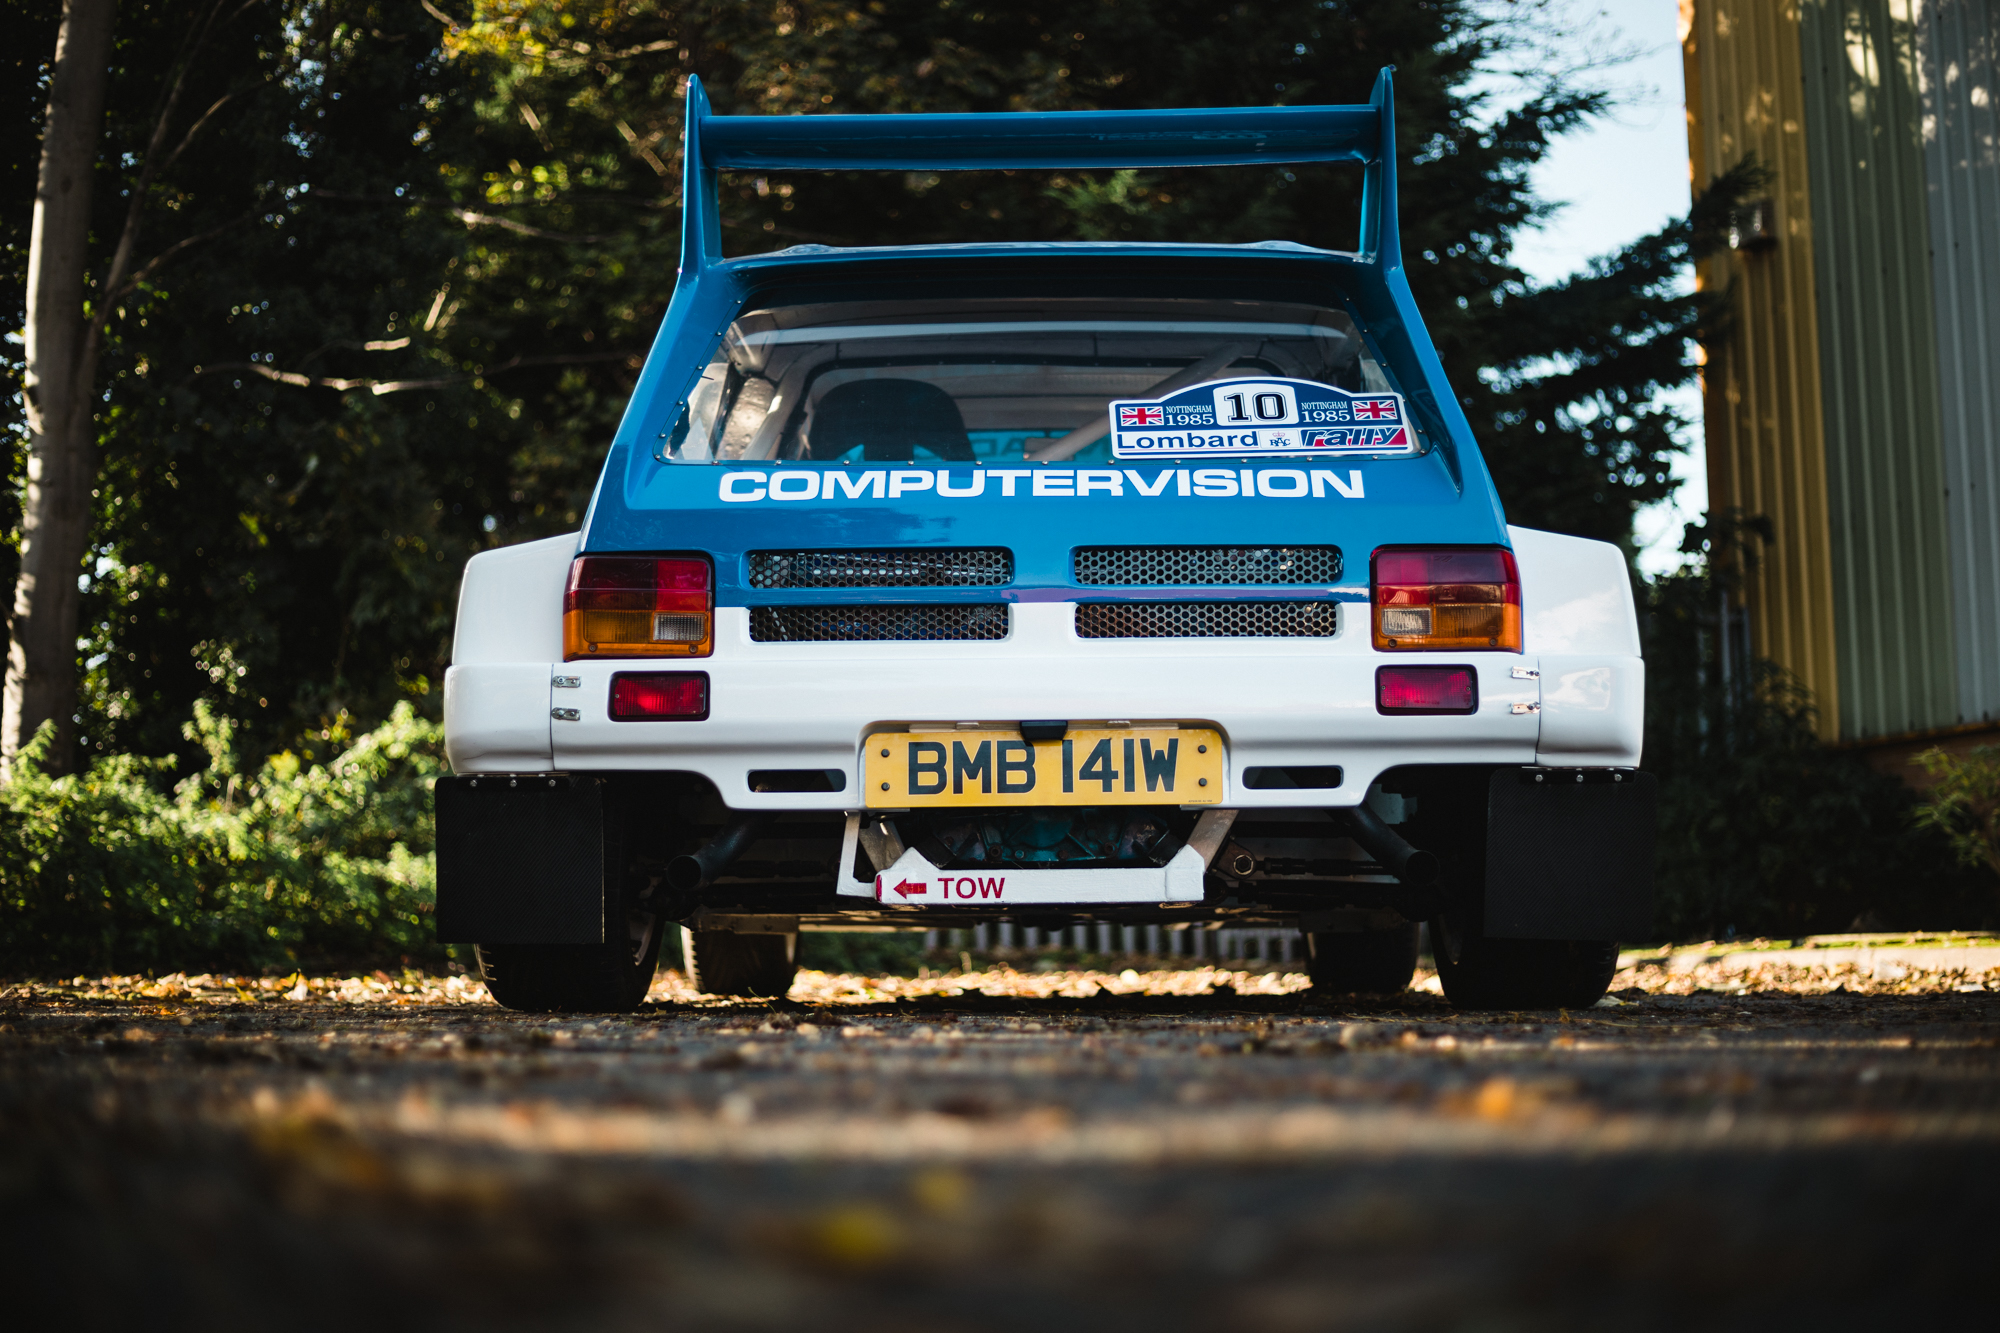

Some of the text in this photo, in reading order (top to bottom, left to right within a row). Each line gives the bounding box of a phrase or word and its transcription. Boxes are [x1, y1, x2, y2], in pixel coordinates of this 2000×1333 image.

[1165, 405, 1213, 414] NOTTINGHAM
[1224, 392, 1288, 422] 10
[1301, 401, 1348, 410] NOTTINGHAM
[1165, 414, 1214, 426] 1985
[1302, 410, 1350, 423] 1985
[1117, 431, 1259, 449] Lombard
[1304, 428, 1401, 447] rally
[719, 469, 1365, 502] COMPUTERVISION
[907, 737, 1179, 796] BMB 141W
[937, 876, 1006, 900] TOW
